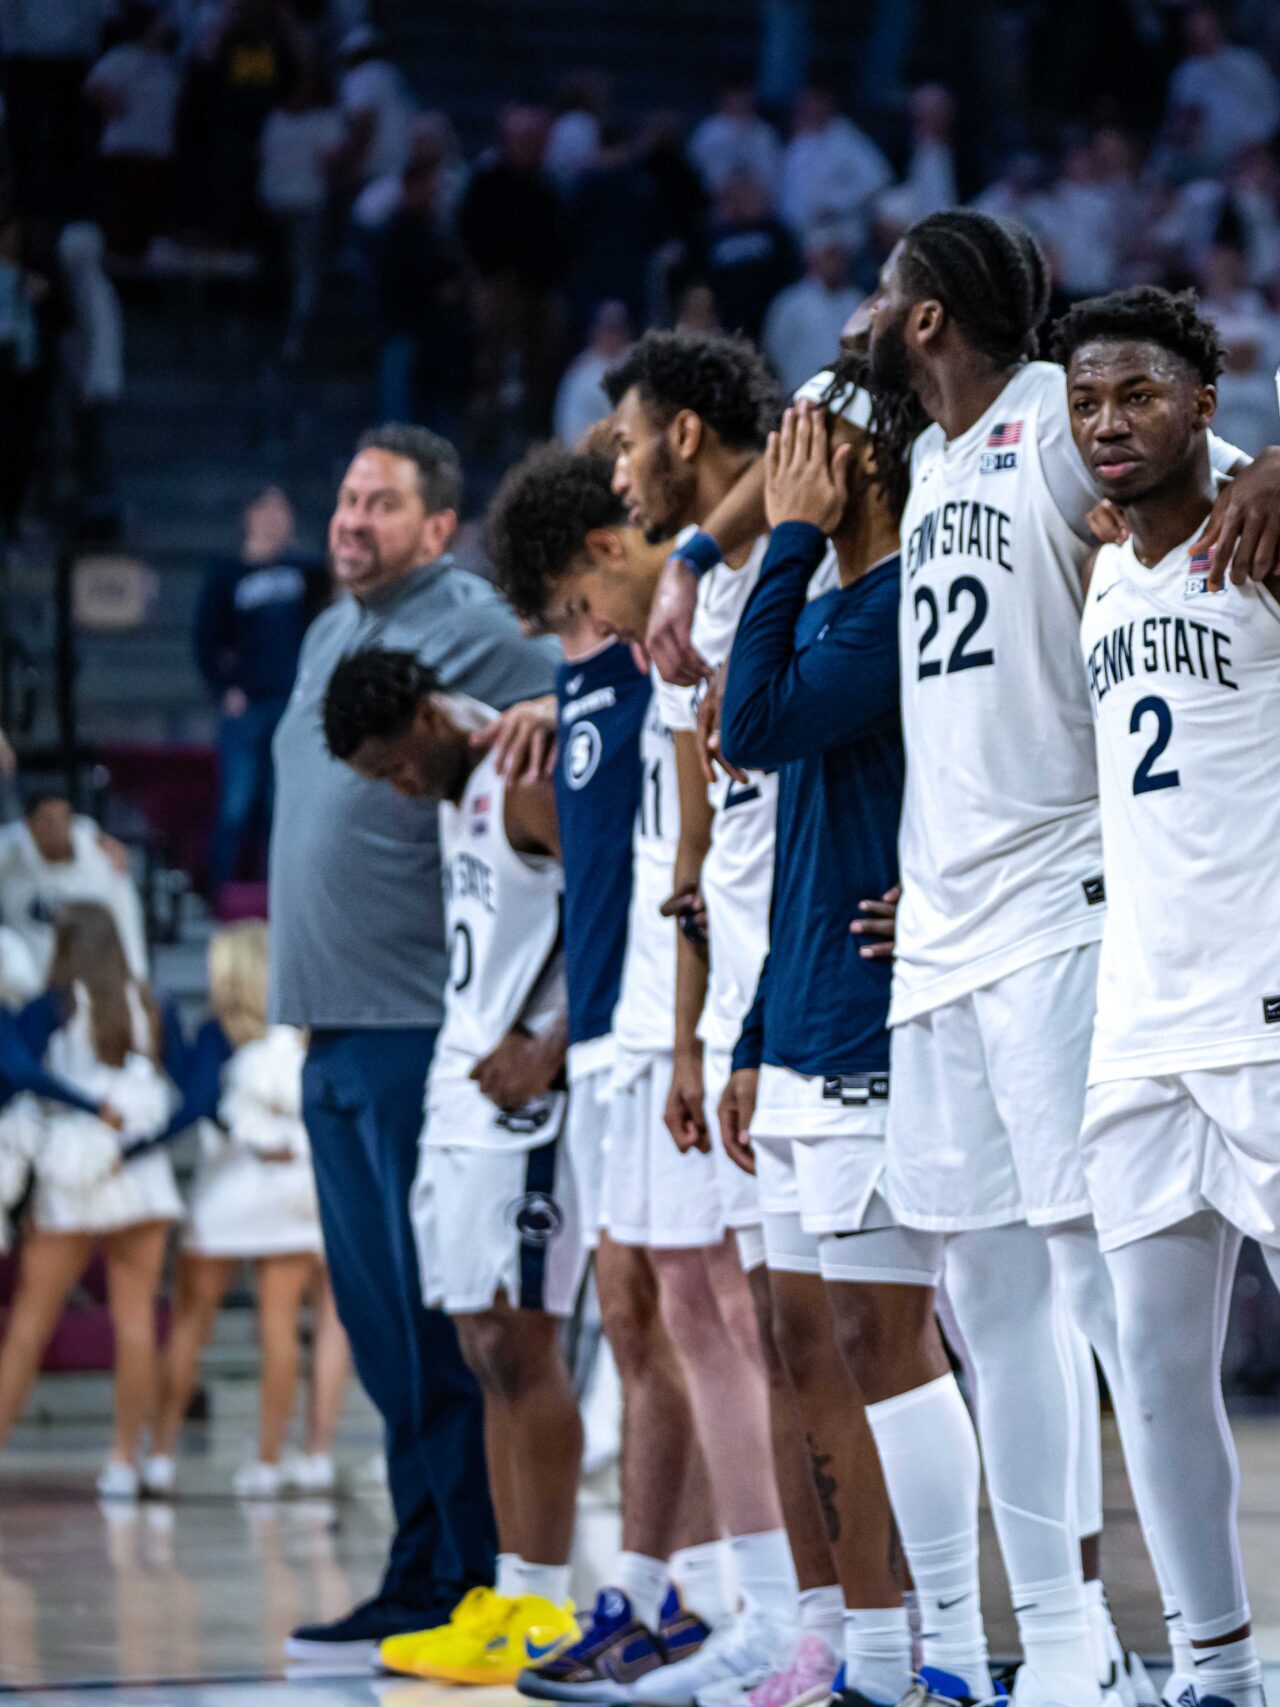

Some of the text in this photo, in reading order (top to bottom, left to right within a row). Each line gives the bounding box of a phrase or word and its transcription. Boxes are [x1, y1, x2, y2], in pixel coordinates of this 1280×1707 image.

[942, 500, 1014, 574] STATE
[914, 574, 995, 682] 22
[1143, 616, 1240, 692] STATE
[1129, 695, 1181, 796] 2
